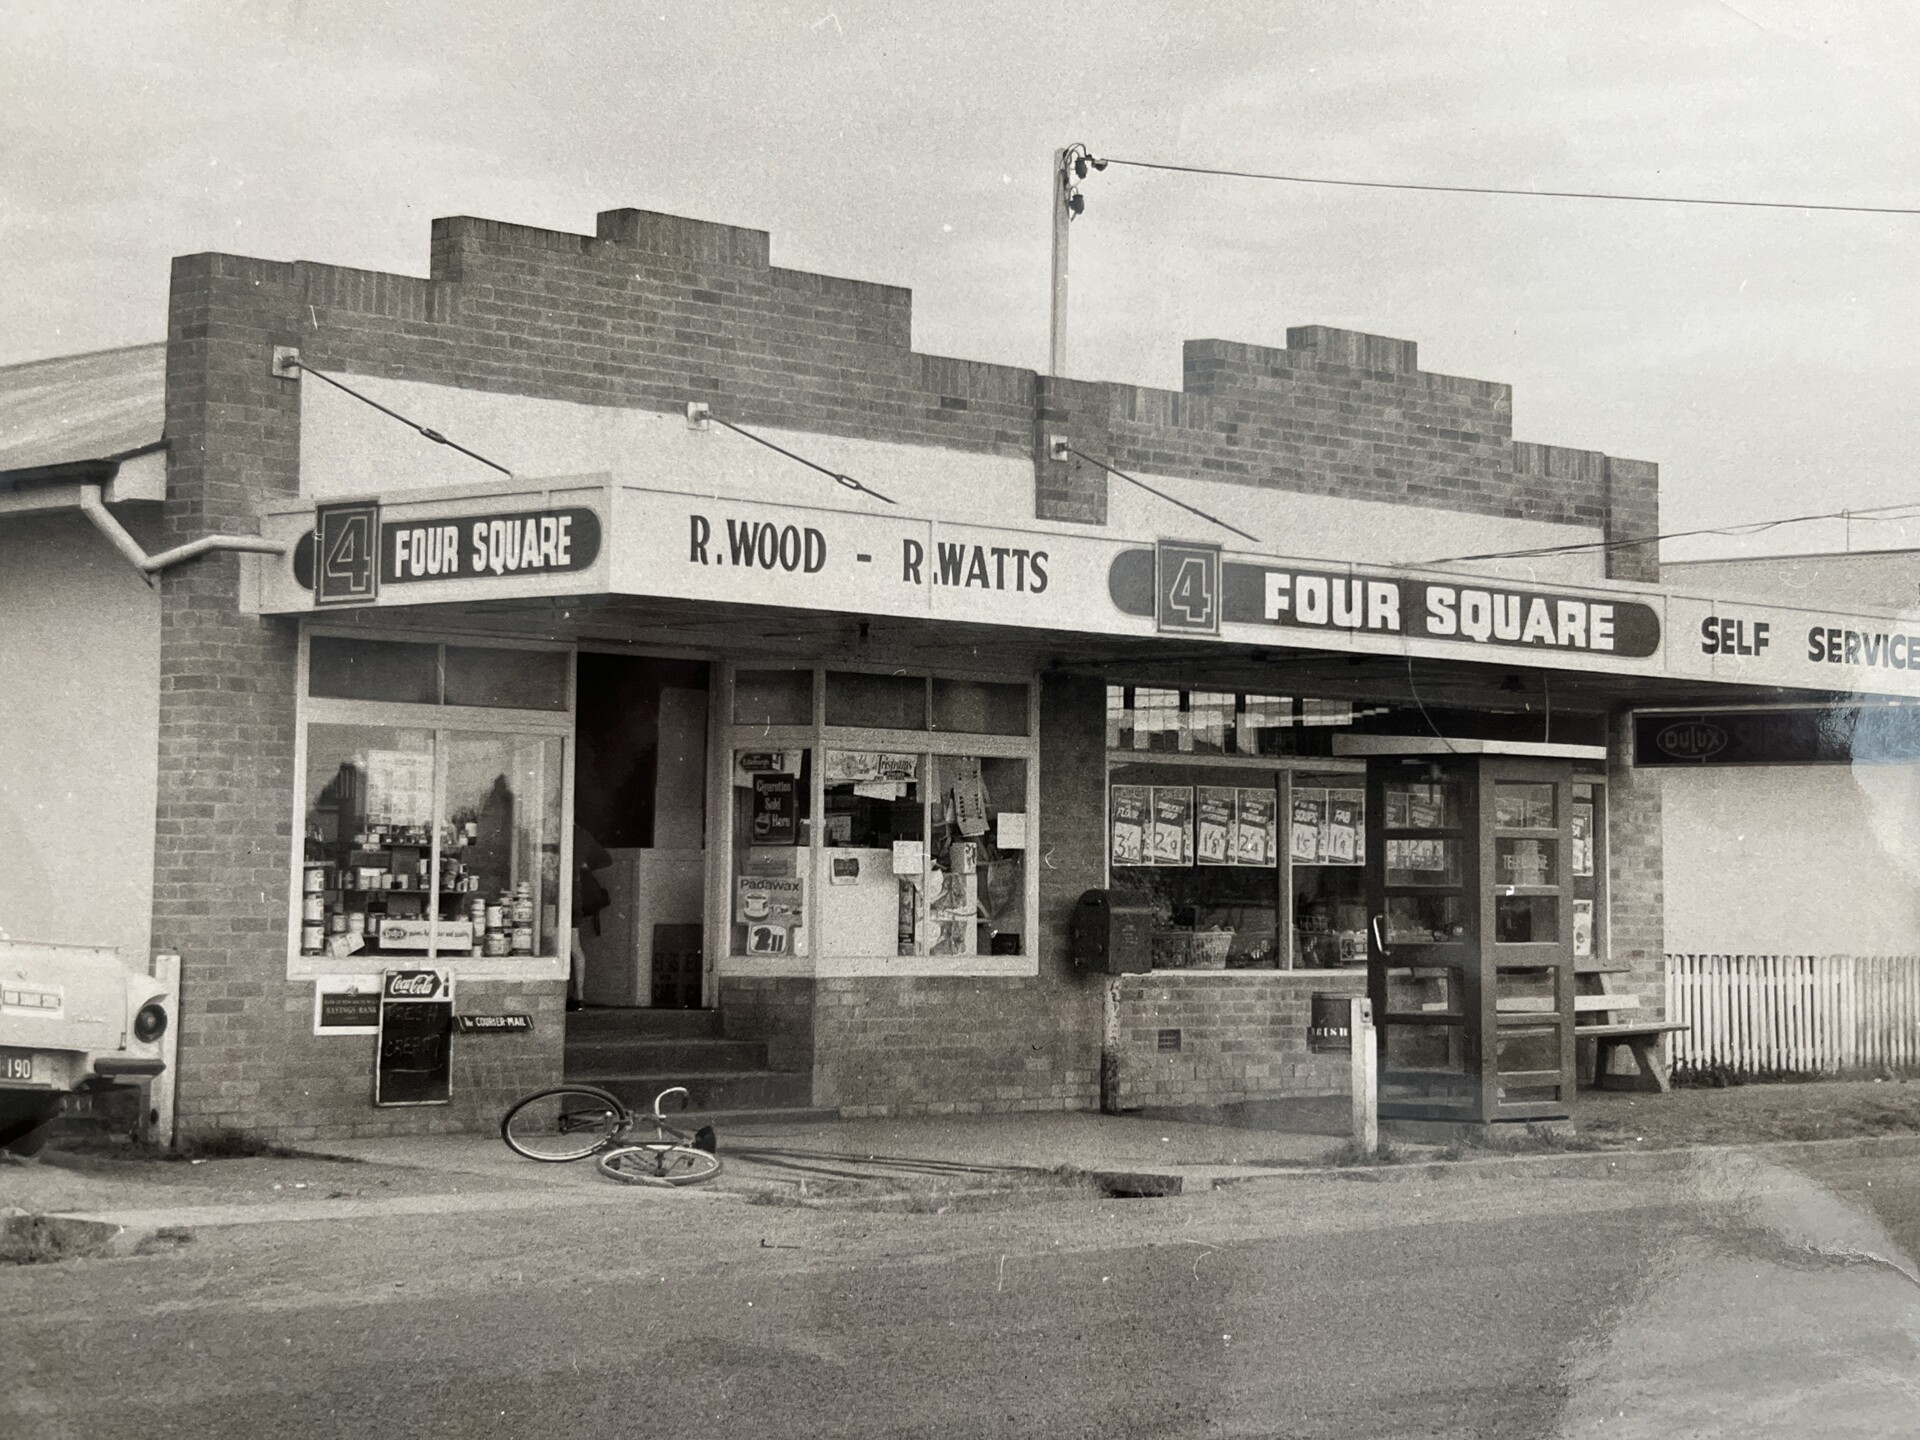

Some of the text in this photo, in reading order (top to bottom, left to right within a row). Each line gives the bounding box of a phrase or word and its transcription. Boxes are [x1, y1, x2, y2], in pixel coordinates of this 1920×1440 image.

[326, 515, 371, 593] 4
[395, 515, 572, 578] FOUR SQUARE
[690, 514, 827, 574] R.WOOD
[1169, 557, 1212, 623] 4
[1264, 571, 1615, 651] FOUR SQUARE
[1701, 616, 1920, 671] SELF SERVICE
[772, 813, 791, 828] Here
[740, 879, 800, 892] Padawax
[475, 1016, 527, 1027] COURIER-MAIL
[8, 1058, 31, 1079] 190
